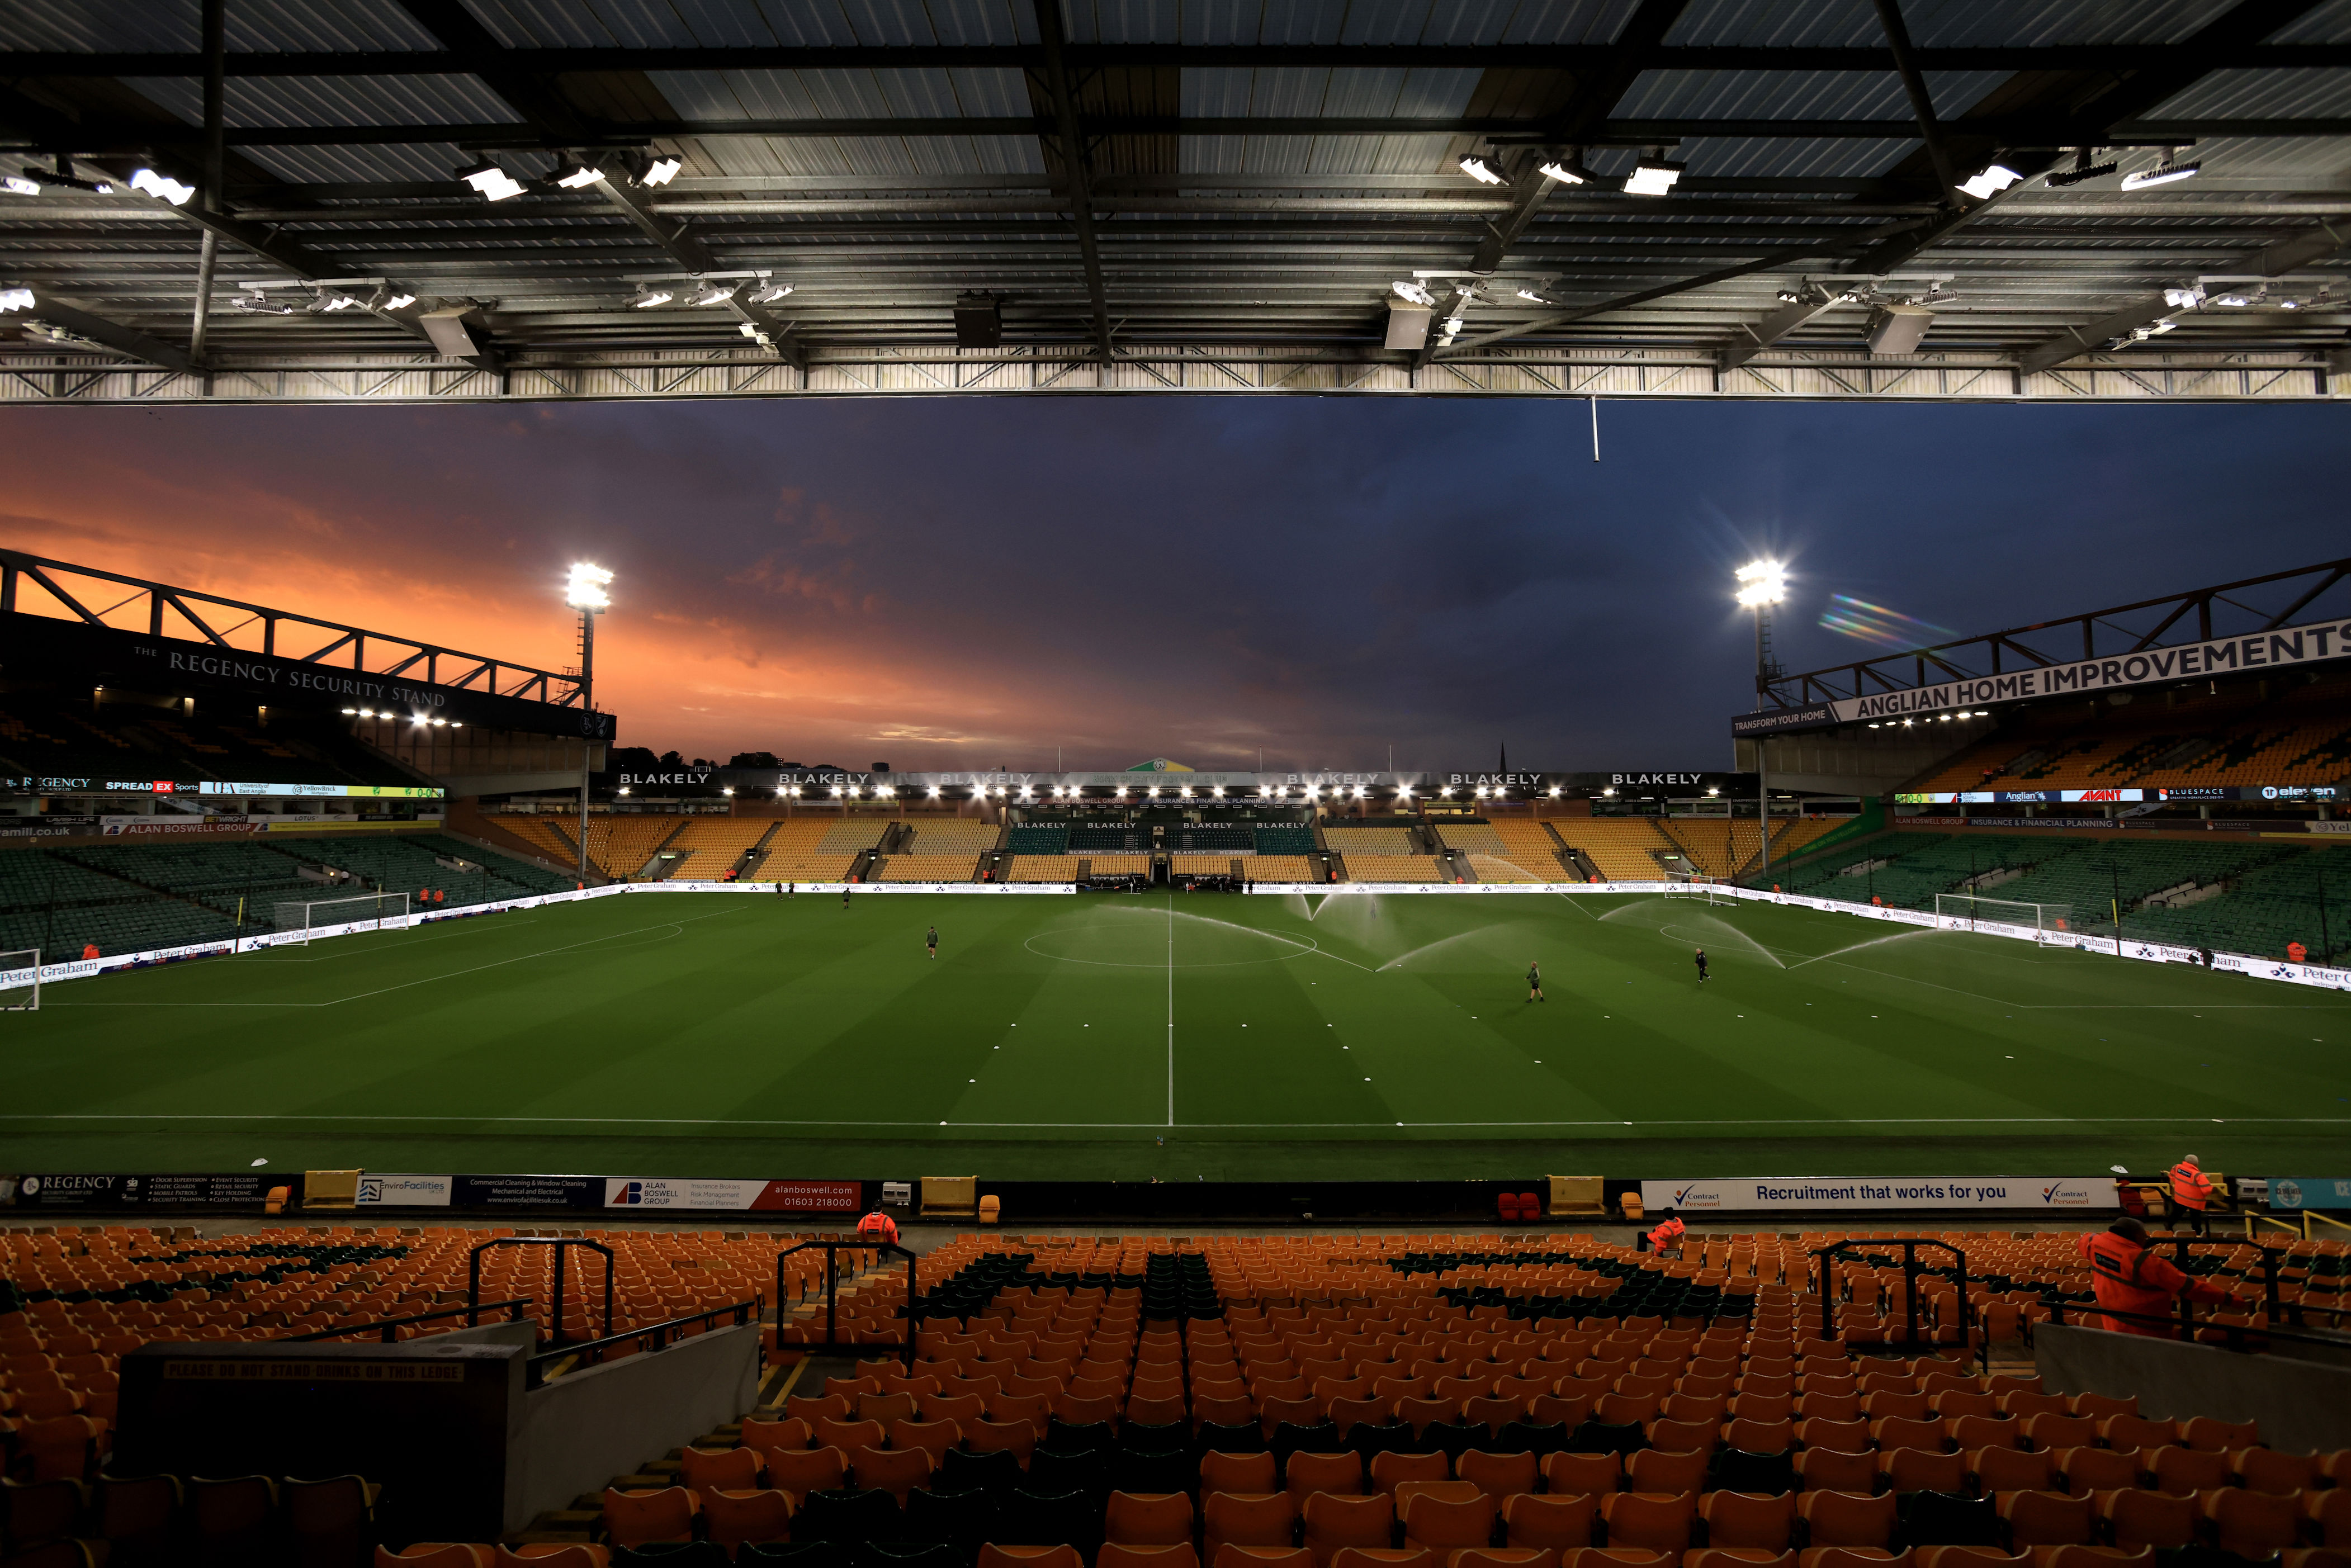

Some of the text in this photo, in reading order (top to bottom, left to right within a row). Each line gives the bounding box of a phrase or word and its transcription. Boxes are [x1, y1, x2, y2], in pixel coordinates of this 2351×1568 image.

[134, 646, 445, 707] THE REGENCY SECURITY STAND
[1858, 687, 1949, 717] ANGLIAN
[1956, 673, 2035, 704] HOME
[1735, 709, 1825, 731] TRANSFORM YOUR HOME
[621, 774, 708, 784] BLAKELY
[779, 774, 868, 784] BLAKELY
[941, 774, 1031, 784] BLAKELY
[1288, 774, 1378, 784] BLAKELY
[1451, 774, 1541, 784] BLAKELY
[1612, 774, 1701, 784] BLAKELY
[175, 783, 199, 792] Sports
[2279, 787, 2336, 796] eleen
[418, 788, 432, 798] 0-0
[2006, 792, 2036, 802] Anglian
[2079, 790, 2122, 801] AVANT
[1908, 794, 1922, 803] 0-0
[129, 823, 252, 834] ALAN BOSWELL GROUP
[1802, 844, 1818, 854] COME
[1893, 910, 1935, 922] Peter Graham
[268, 929, 325, 943] Peter Graham
[2051, 931, 2114, 949] Peter Graham
[41, 963, 97, 977] Graham
[2302, 967, 2341, 982] Peter
[43, 1176, 116, 1190] REGENCY
[380, 1181, 445, 1190] EnviroFacilities
[775, 1185, 853, 1195] alanboswell.com
[1757, 1185, 2007, 1202] Recruitment that works for you
[784, 1198, 852, 1207] 01603 218000
[169, 1363, 458, 1379] PLEASE DO NOT STAND DRINKS ON THIS LEDGE
